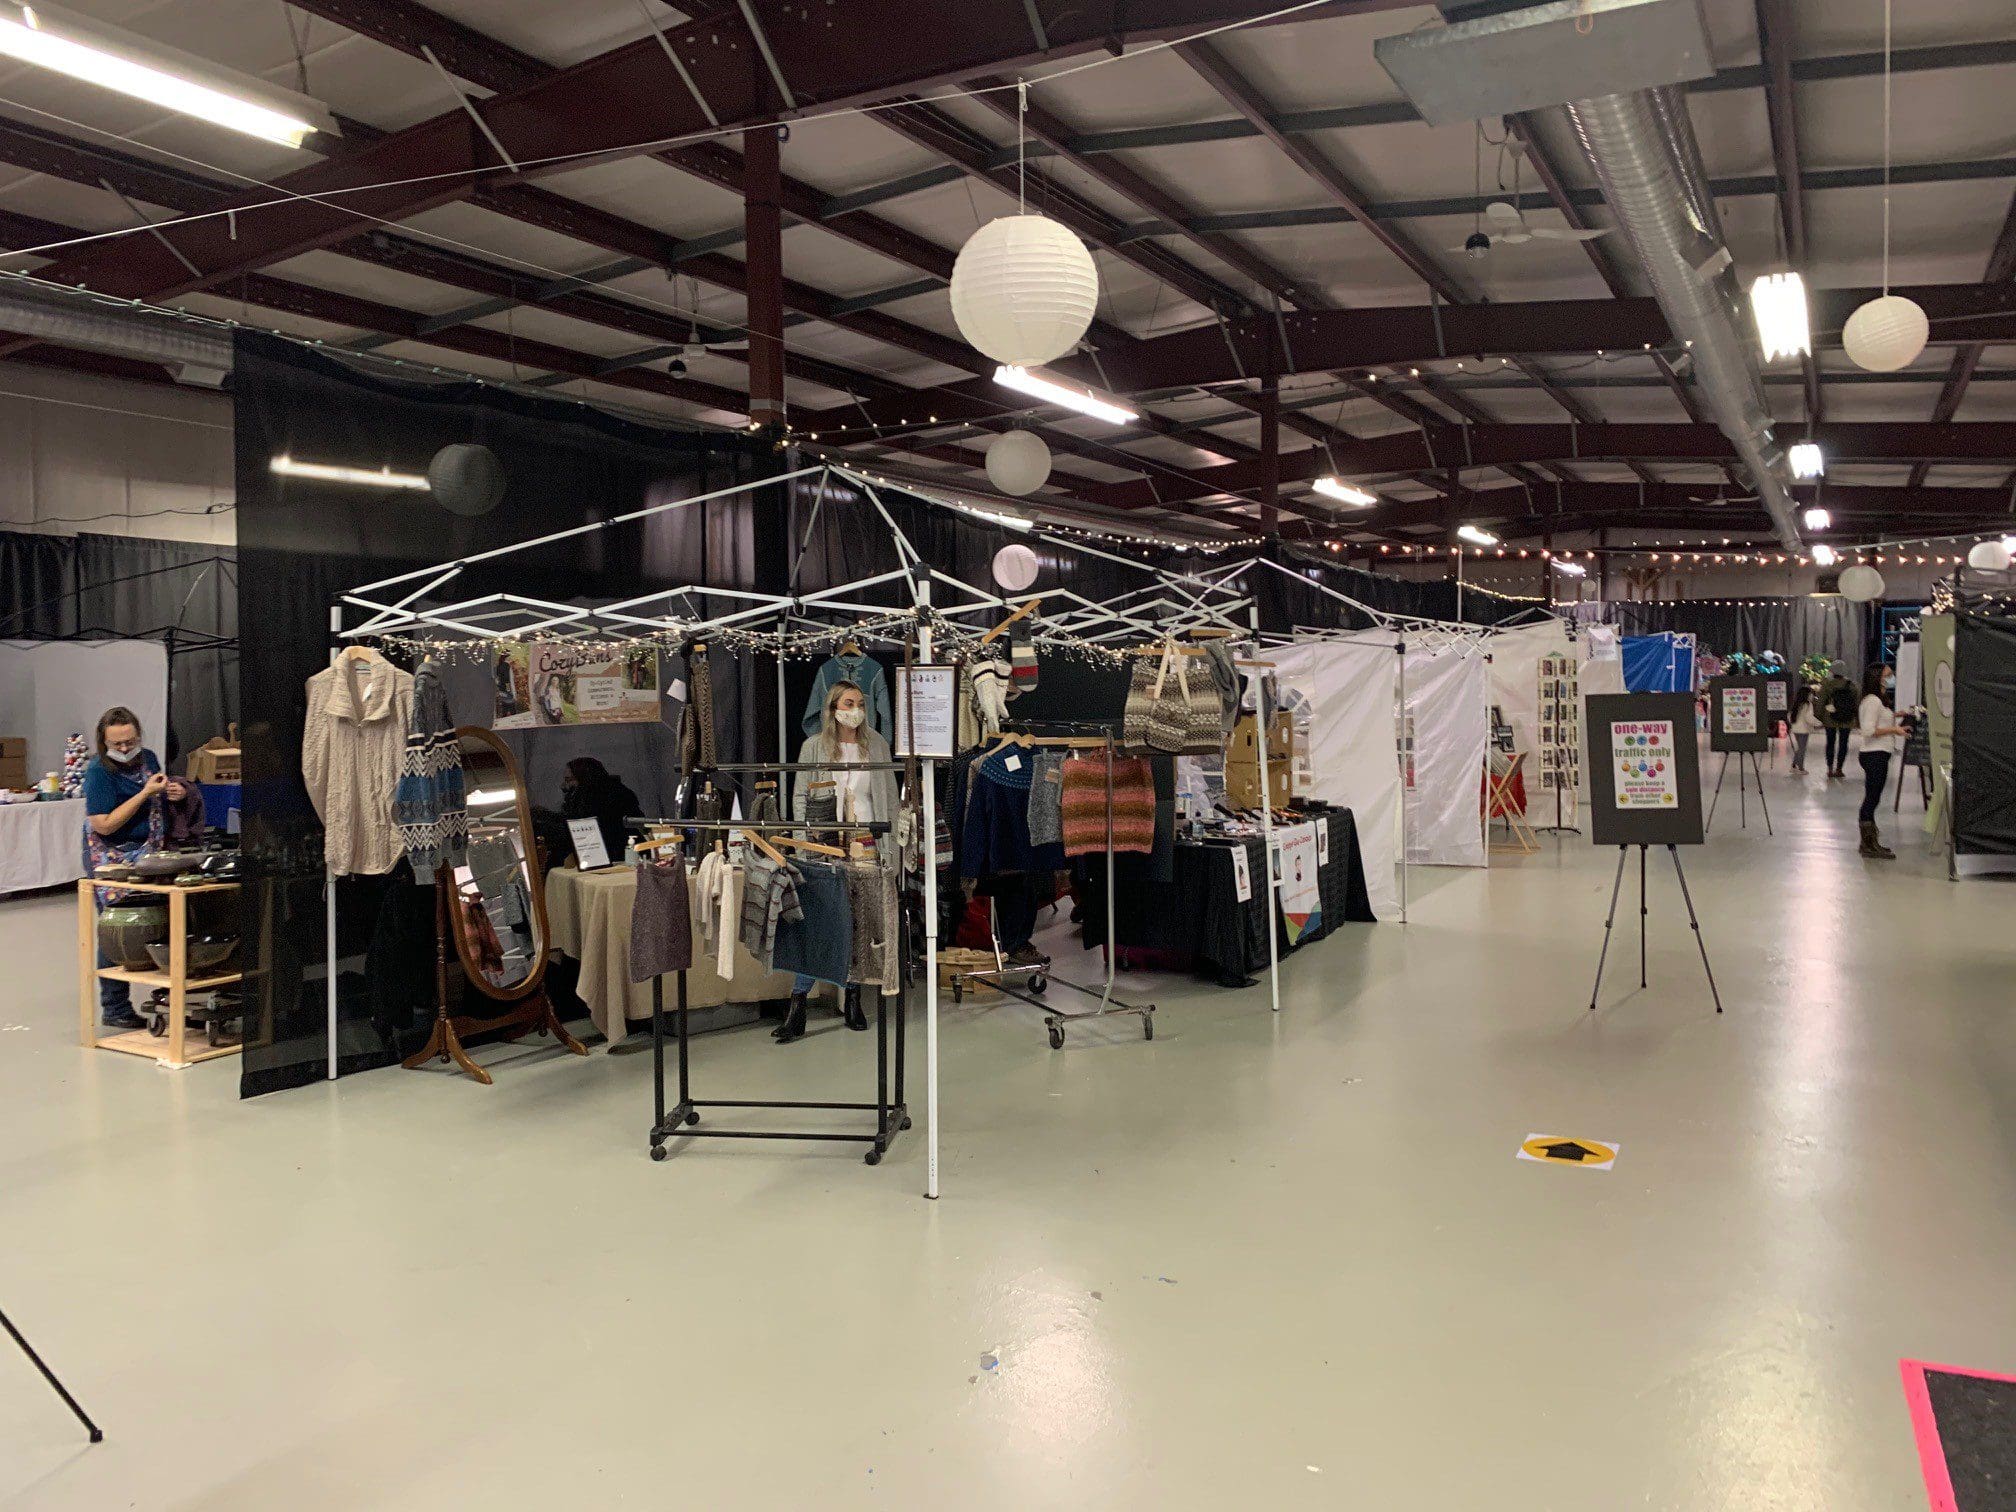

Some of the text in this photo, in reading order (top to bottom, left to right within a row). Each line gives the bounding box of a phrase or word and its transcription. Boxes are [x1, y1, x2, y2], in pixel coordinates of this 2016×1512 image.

[1614, 723, 1667, 734] one-way
[1614, 747, 1671, 757] traffic only
